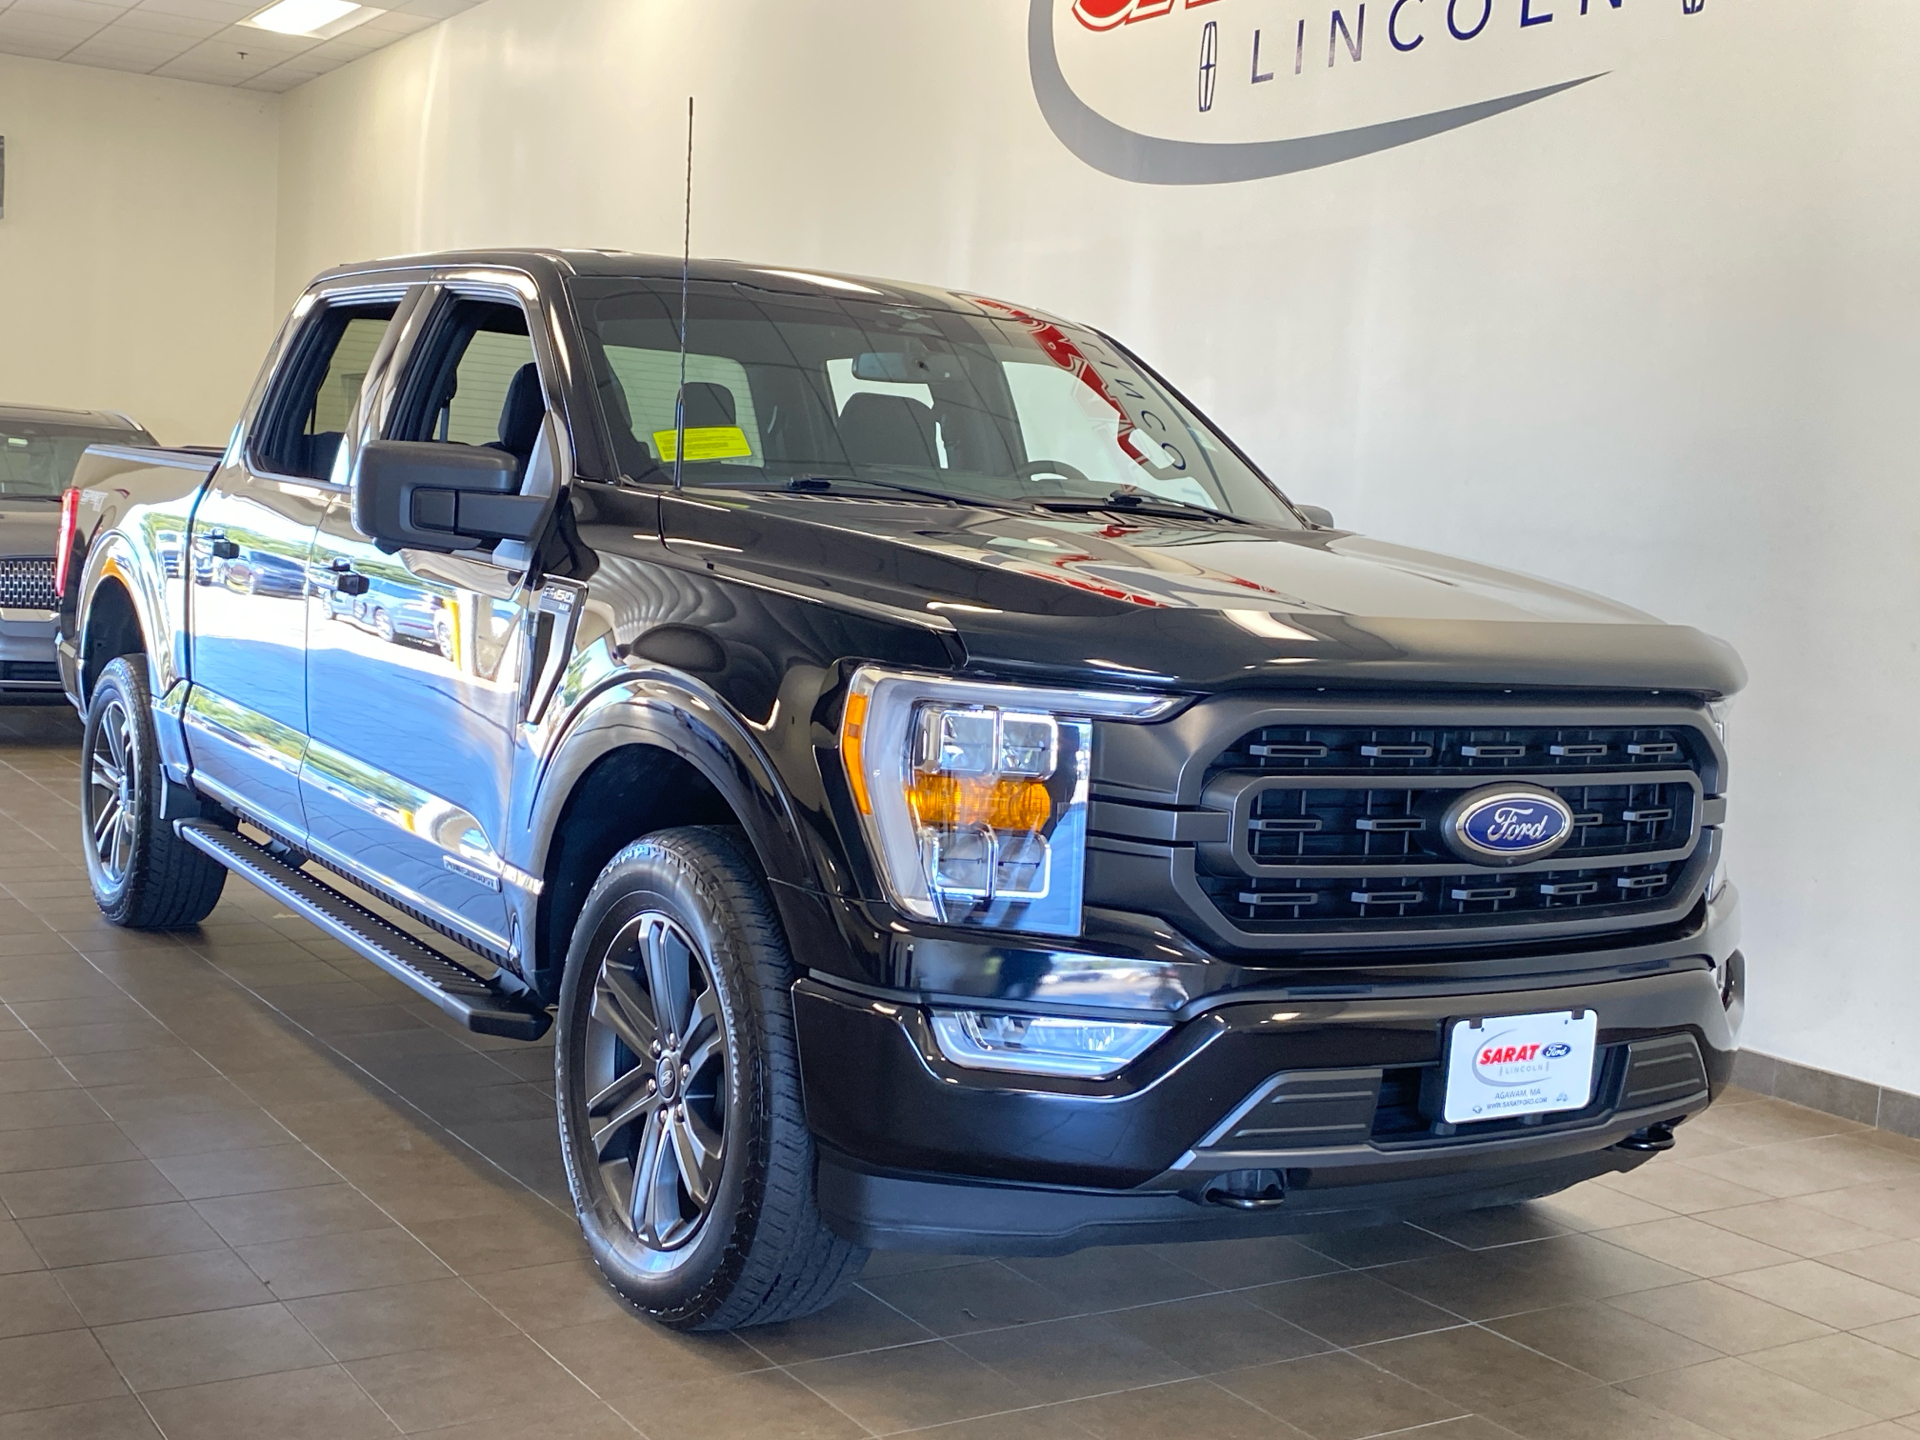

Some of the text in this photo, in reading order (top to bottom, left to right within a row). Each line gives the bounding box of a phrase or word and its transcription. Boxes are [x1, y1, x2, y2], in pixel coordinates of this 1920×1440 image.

[1251, 0, 1623, 84] LINCOL
[1487, 806, 1549, 842] Ford
[1479, 1043, 1568, 1066] SARAT Ford
[1505, 1063, 1544, 1075] LINCOLN
[1530, 1088, 1541, 1096] MA
